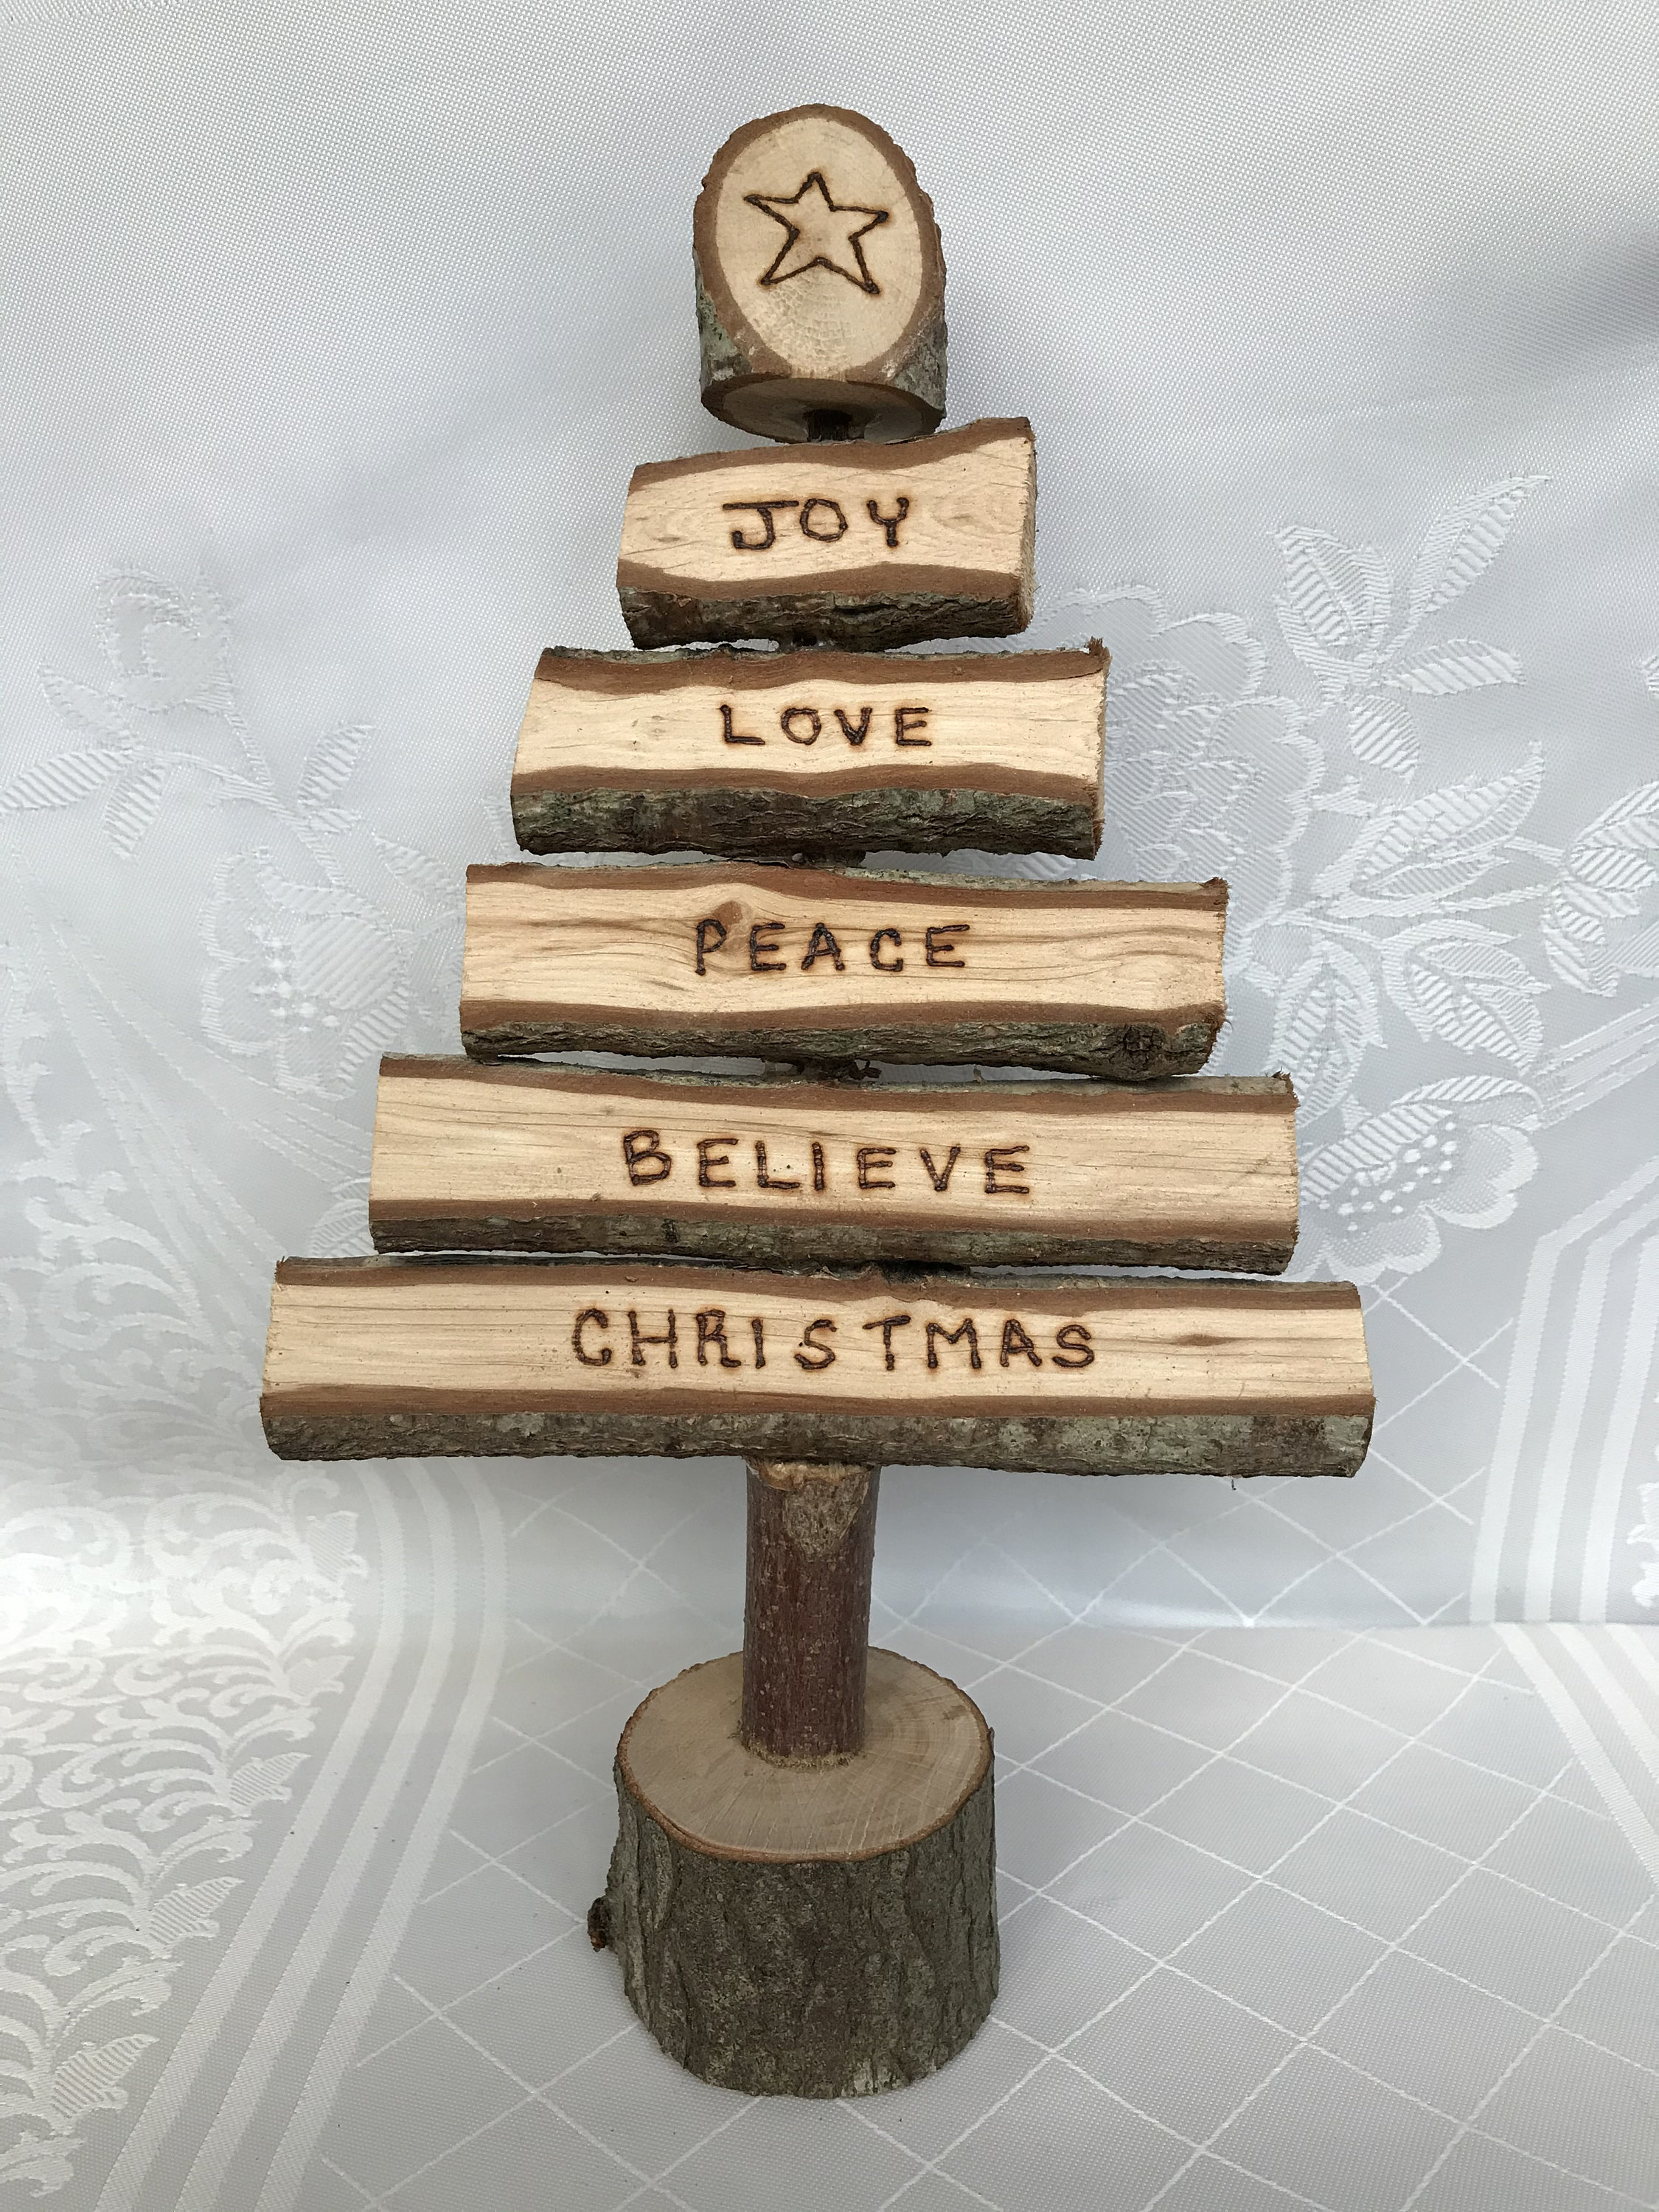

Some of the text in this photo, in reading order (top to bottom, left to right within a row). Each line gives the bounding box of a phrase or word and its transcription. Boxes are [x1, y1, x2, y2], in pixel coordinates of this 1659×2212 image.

[722, 496, 910, 550] JOY
[719, 703, 933, 746] LOVE
[694, 918, 970, 976] PEACE
[622, 1130, 1030, 1194] BELIEVE
[571, 1307, 1096, 1371] CHRISTMAS
